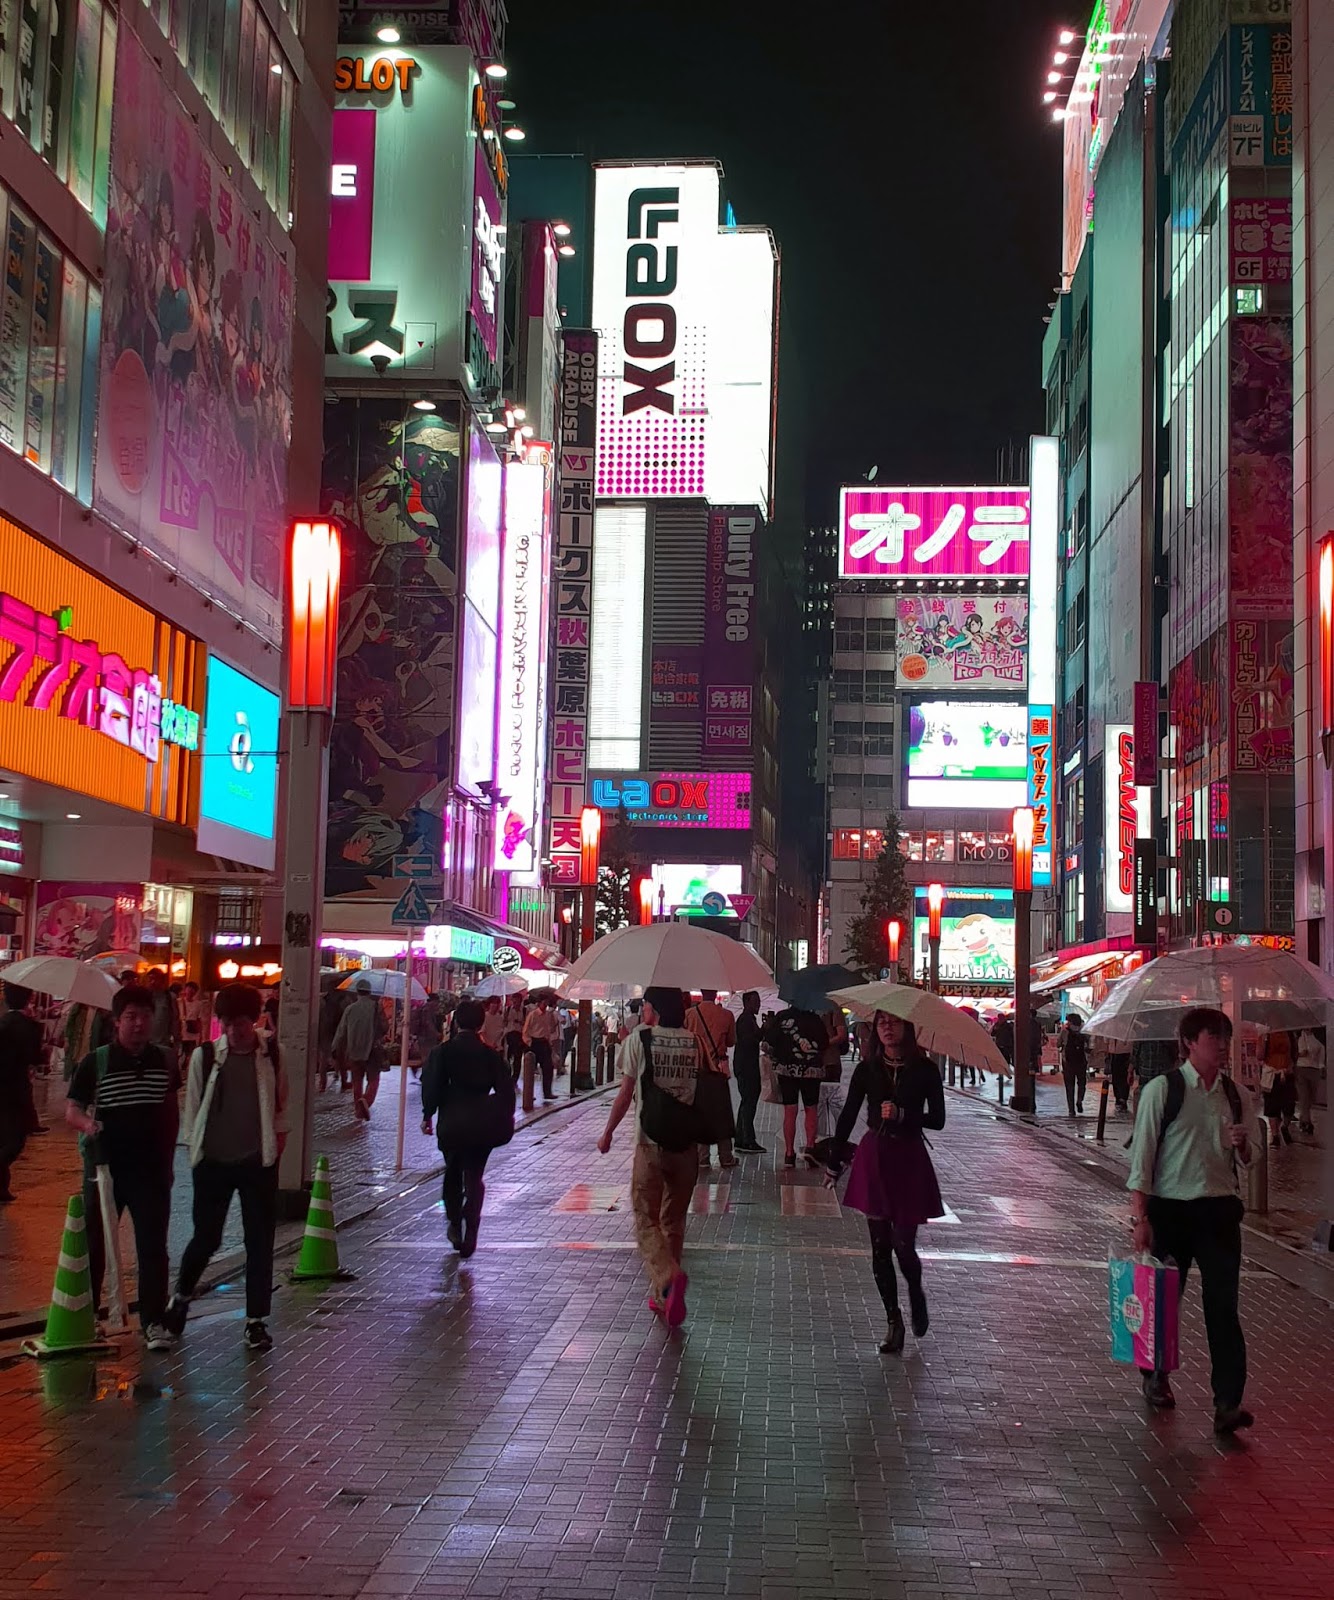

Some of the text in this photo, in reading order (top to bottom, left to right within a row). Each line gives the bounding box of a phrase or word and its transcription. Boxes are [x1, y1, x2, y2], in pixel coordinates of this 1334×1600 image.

[360, 12, 449, 26] ARADISE
[335, 57, 416, 92] SLOT
[1241, 27, 1256, 112] レオパレス21
[1233, 138, 1261, 156] 7F
[1234, 201, 1292, 221] ホビー
[1238, 261, 1261, 277] 6F
[725, 517, 756, 642] Duty Free
[711, 691, 748, 709] 免税
[1235, 621, 1257, 770] カードゲム専門店
[709, 725, 748, 739] 면세점
[1032, 718, 1049, 735] 薬
[626, 811, 678, 821] lectronics
[1118, 732, 1137, 896] GAMERS
[938, 963, 1016, 980] IHABAR
[654, 1053, 671, 1066] UJI
